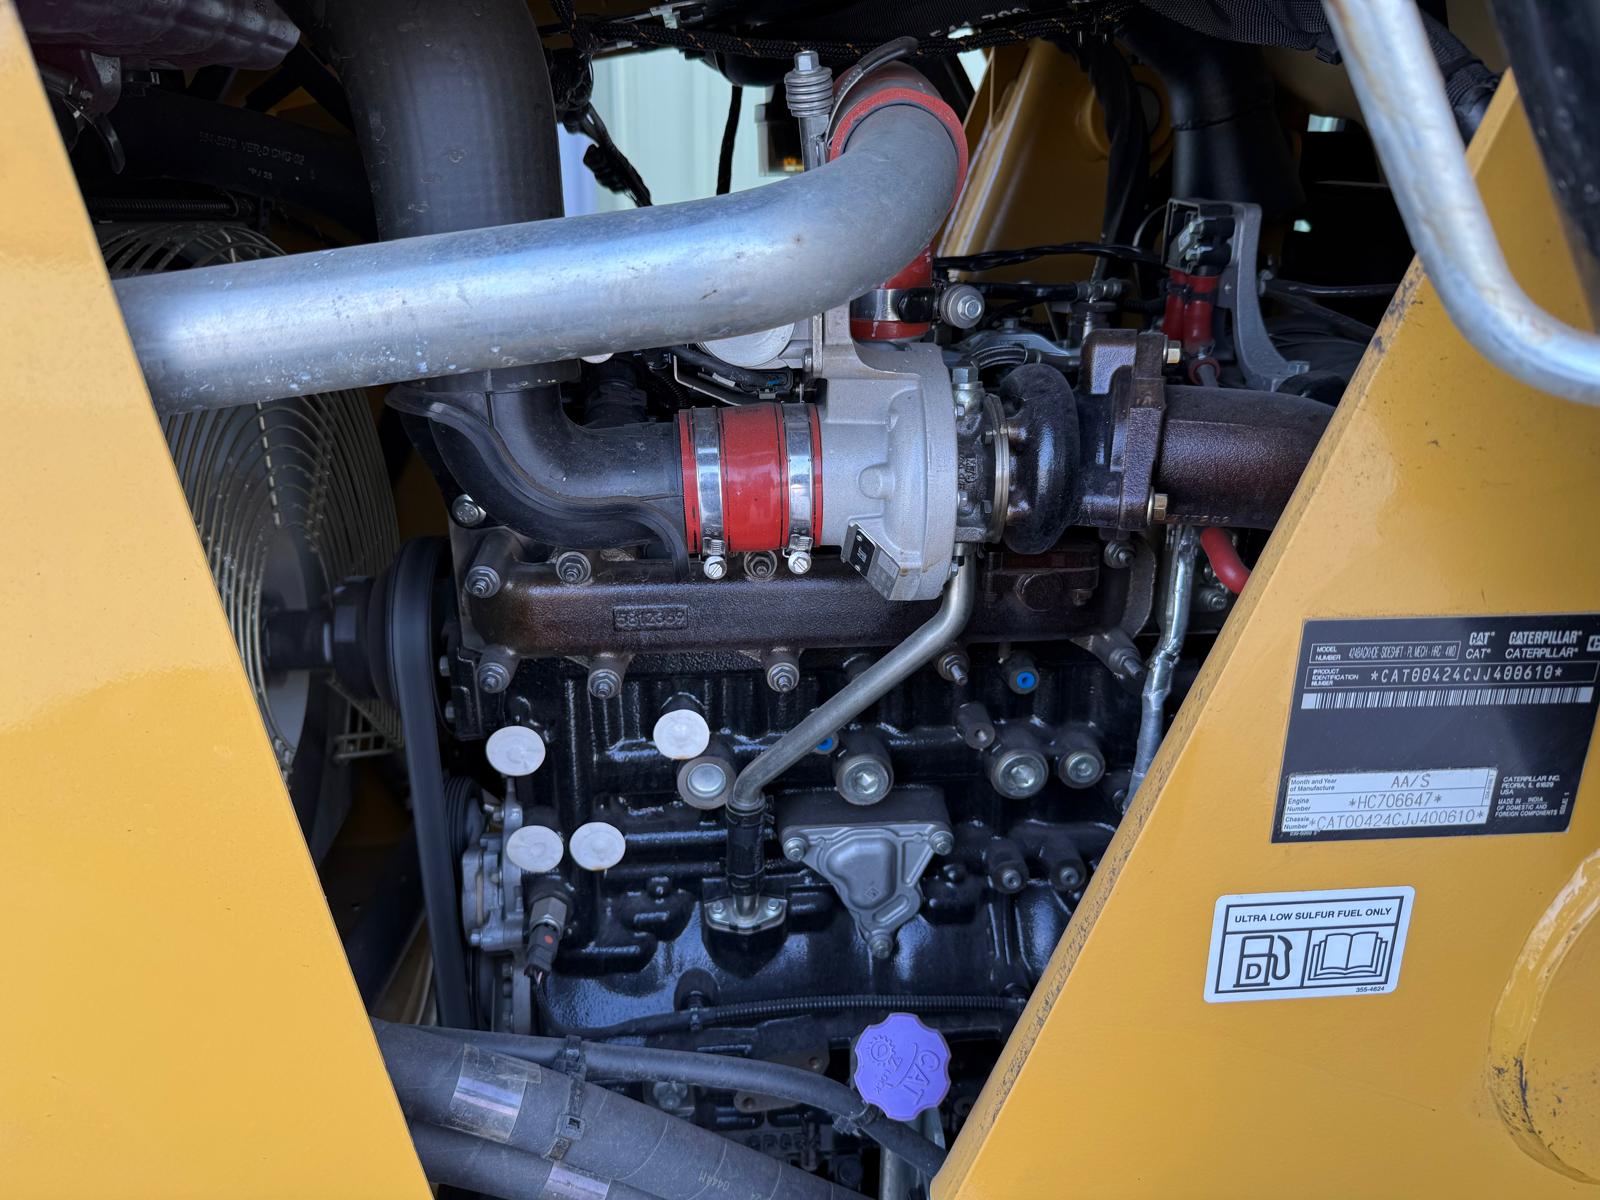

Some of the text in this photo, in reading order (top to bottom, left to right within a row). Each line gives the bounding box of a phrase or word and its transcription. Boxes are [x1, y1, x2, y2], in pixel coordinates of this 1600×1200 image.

[1316, 645, 1337, 653] MODEL
[1390, 773, 1431, 789] AA/S
[1502, 775, 1548, 783] CATERPILLAR
[1287, 798, 1310, 806] Engine
[1495, 809, 1558, 818] FOREIGN COMPONENTS
[1283, 822, 1308, 830] Number
[1234, 907, 1392, 924] ULTRA LOW SULFUR FUEL ONLY
[1244, 963, 1262, 980] D
[902, 1049, 942, 1106] CAT
